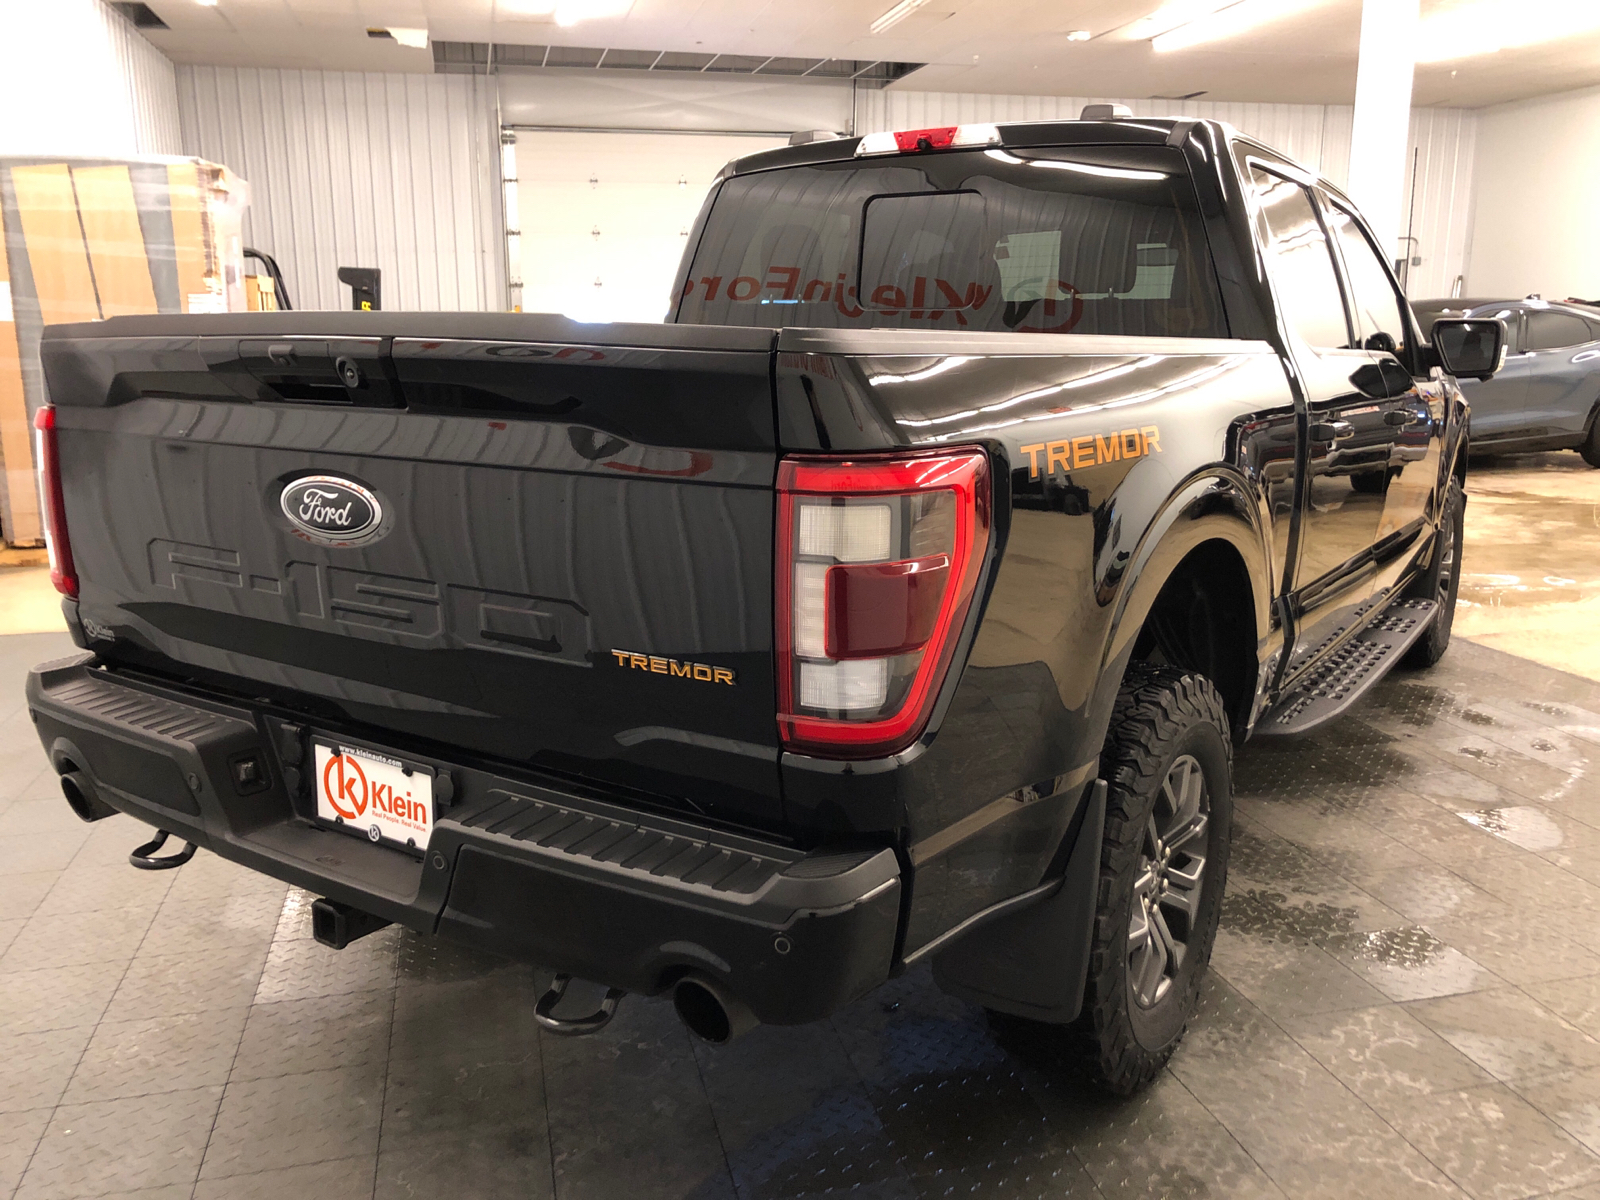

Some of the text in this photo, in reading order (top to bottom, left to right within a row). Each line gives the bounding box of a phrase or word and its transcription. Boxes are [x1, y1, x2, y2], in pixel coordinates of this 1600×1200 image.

[1020, 425, 1163, 478] TREMOR
[299, 488, 353, 526] Ford
[147, 537, 594, 668] F-150
[611, 648, 737, 686] TREMOR
[338, 744, 403, 769] www.kleinauto.com
[371, 780, 427, 825] Klein
[372, 809, 383, 819] Real
[401, 819, 412, 828] Real
